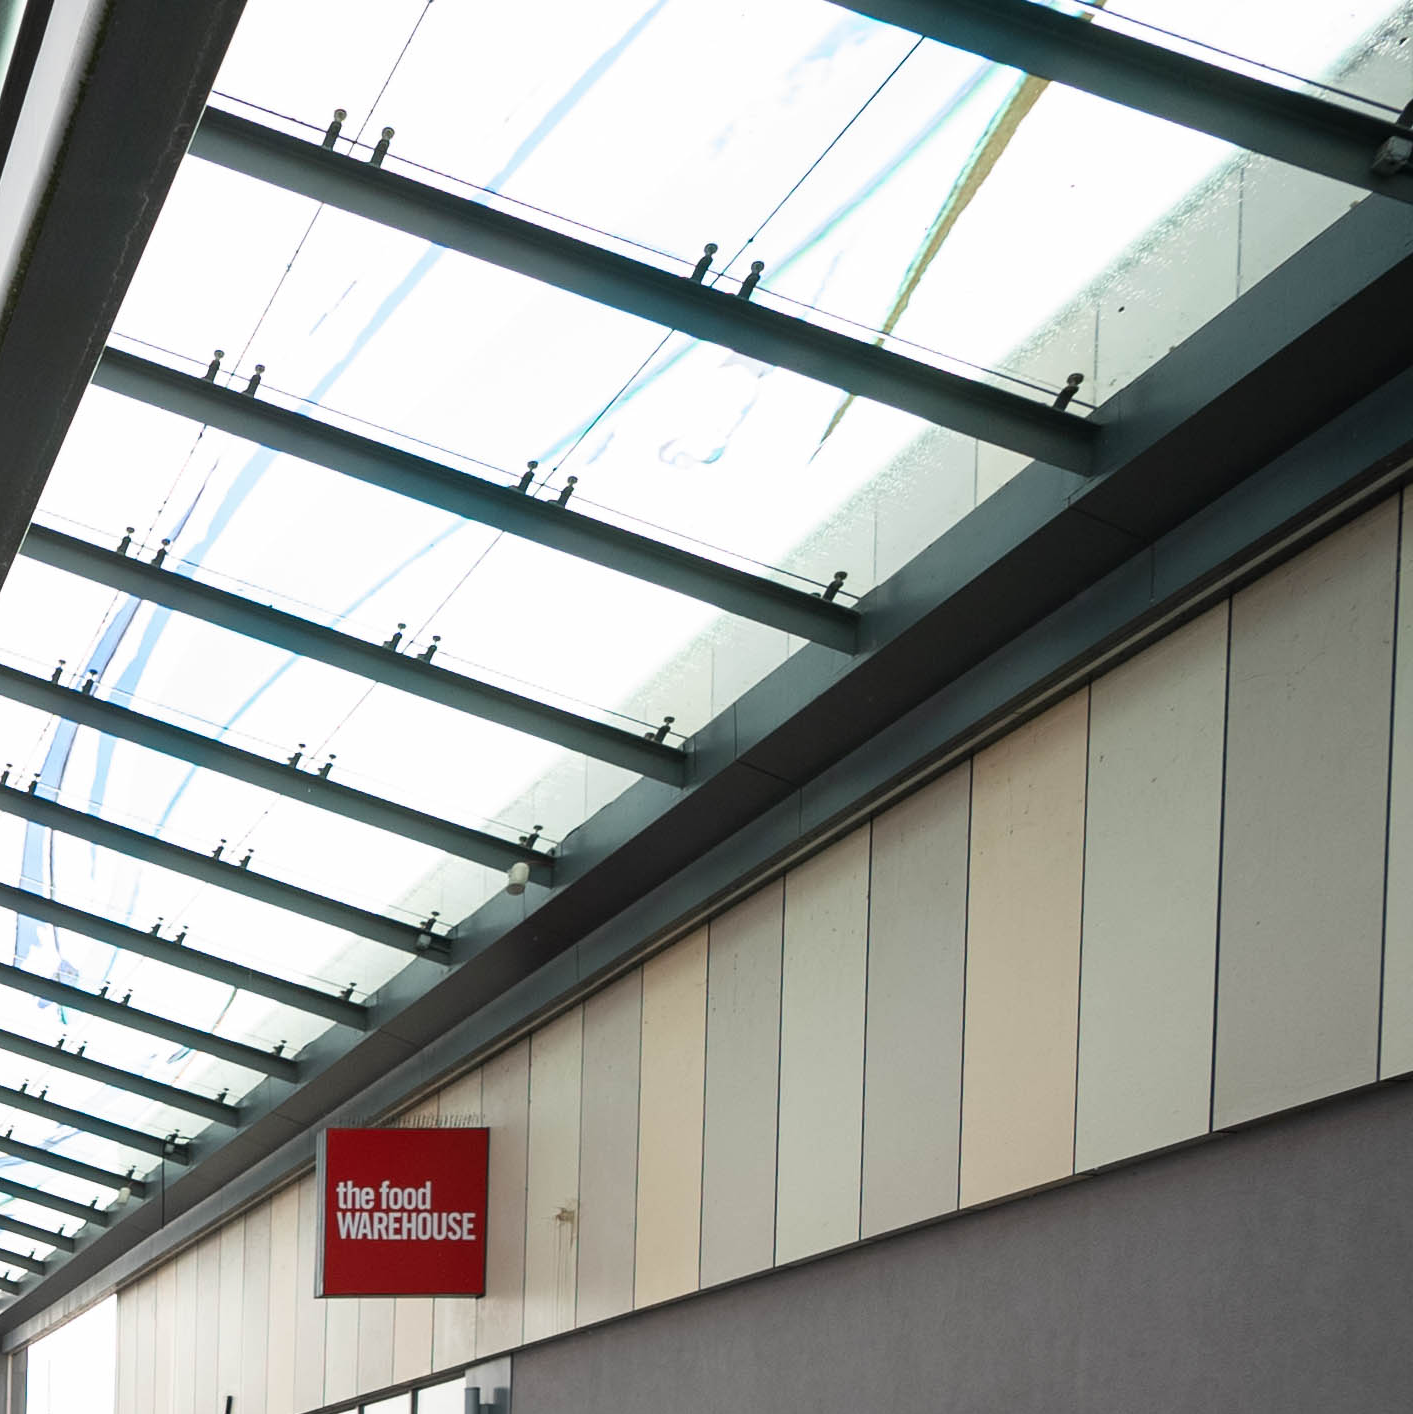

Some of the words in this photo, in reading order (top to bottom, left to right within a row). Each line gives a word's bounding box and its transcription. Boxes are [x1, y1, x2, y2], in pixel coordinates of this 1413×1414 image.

[336, 1180, 374, 1209] the
[379, 1180, 431, 1209] food
[336, 1212, 476, 1241] WAREHOUSE
